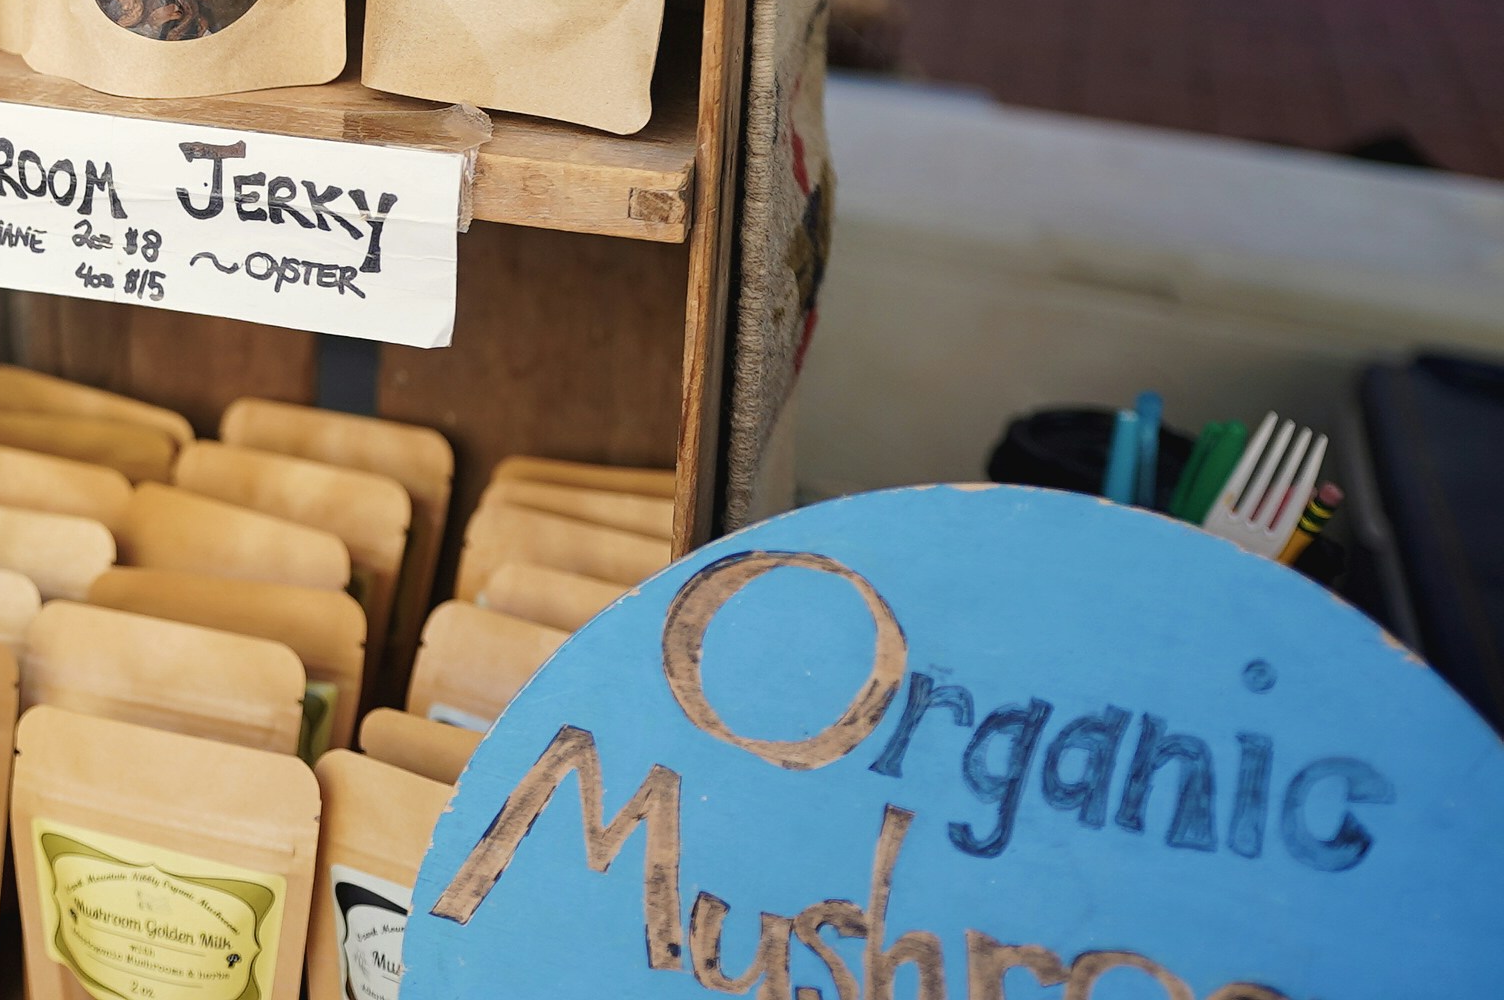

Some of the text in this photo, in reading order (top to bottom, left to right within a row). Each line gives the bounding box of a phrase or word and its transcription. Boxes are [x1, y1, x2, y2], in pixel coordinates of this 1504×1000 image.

[175, 139, 398, 273] JERKY
[123, 226, 163, 263] $8
[75, 262, 166, 302] 4oz $15
[661, 549, 1396, 872] Organic
[74, 897, 232, 951] Mushroom Golden Milk
